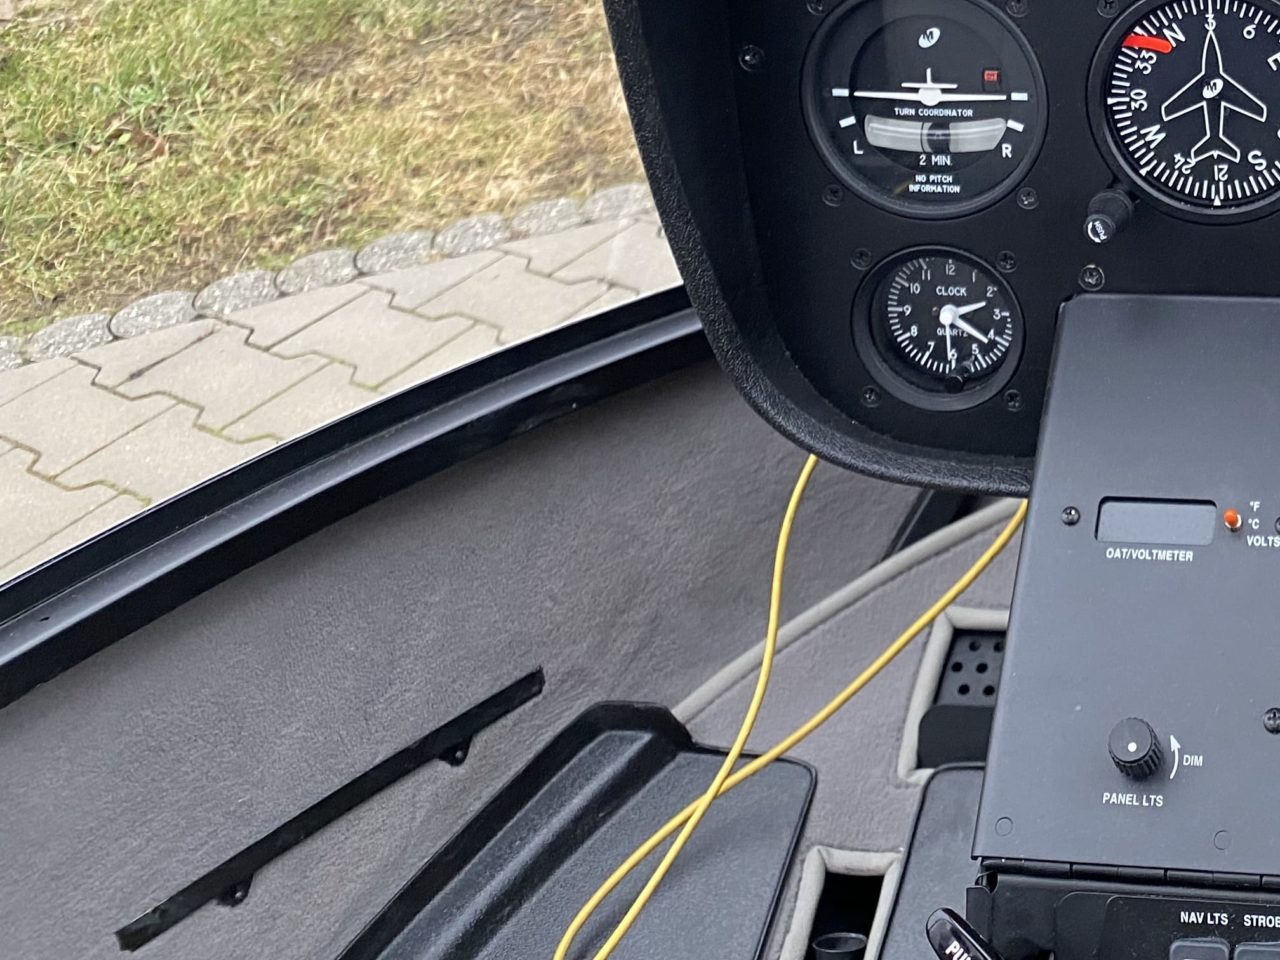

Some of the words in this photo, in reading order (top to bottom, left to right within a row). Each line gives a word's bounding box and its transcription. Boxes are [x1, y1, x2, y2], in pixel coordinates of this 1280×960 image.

[1162, 23, 1185, 47] N
[894, 108, 915, 116] TURN
[918, 108, 973, 117] COORDINATOR
[1140, 124, 1166, 148] W
[853, 140, 864, 154] L
[1002, 143, 1012, 158] R
[919, 155, 926, 165] 2
[1247, 150, 1266, 170] S
[915, 175, 927, 183] NO
[929, 175, 952, 183] PITCH
[909, 184, 960, 193] INFORMATION
[936, 287, 967, 296] CLOCK
[1250, 501, 1260, 512] °F
[1248, 519, 1259, 529] °C
[1247, 536, 1280, 547] VOLTS
[1106, 548, 1193, 561] OAT/VOLTMETER
[1183, 755, 1203, 766] DIM
[1103, 793, 1139, 805] PANEL
[1142, 795, 1163, 806] LTS
[1180, 911, 1204, 924] NAV
[1207, 912, 1228, 925] LTS
